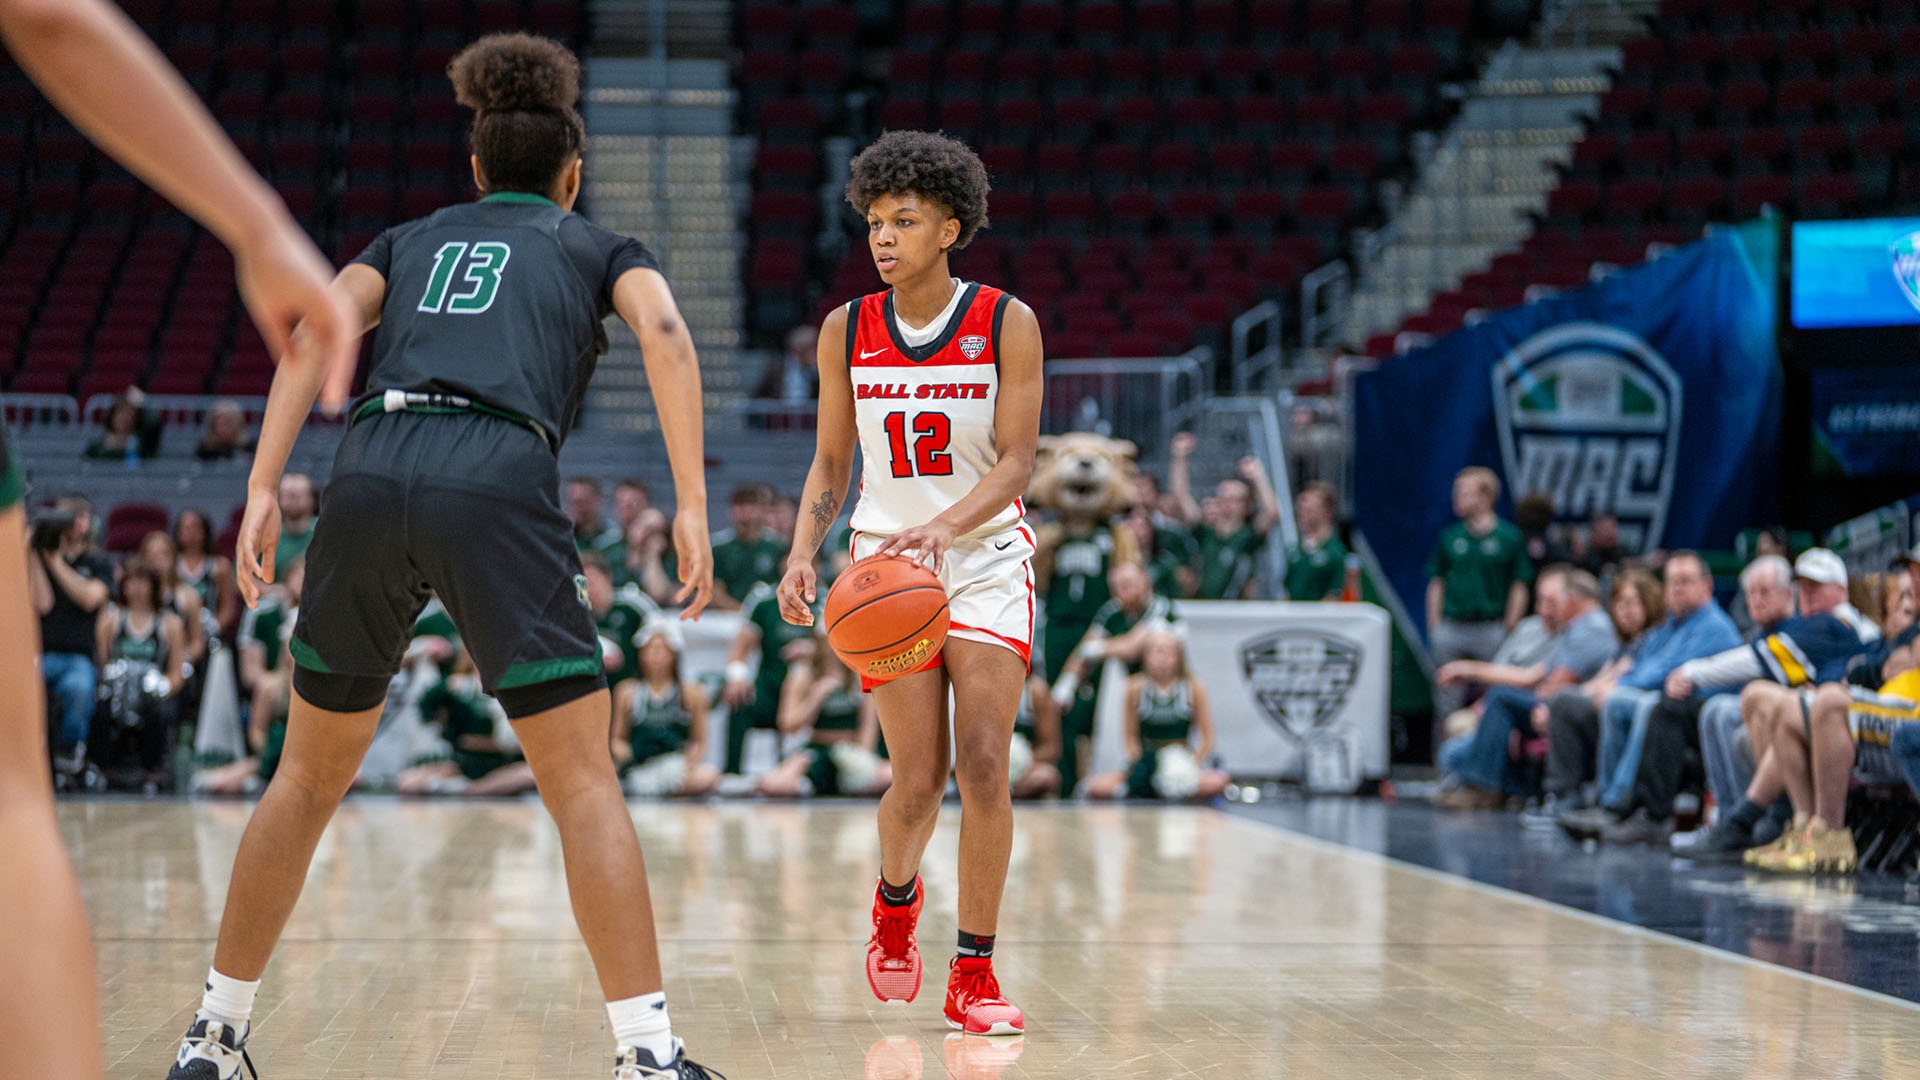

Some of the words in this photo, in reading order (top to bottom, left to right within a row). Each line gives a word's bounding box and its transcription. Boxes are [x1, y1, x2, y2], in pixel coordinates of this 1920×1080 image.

[417, 241, 511, 314] 13
[857, 383, 911, 400] BALL
[914, 383, 990, 399] STATE
[884, 411, 953, 478] 12
[1517, 436, 1663, 518] MAC
